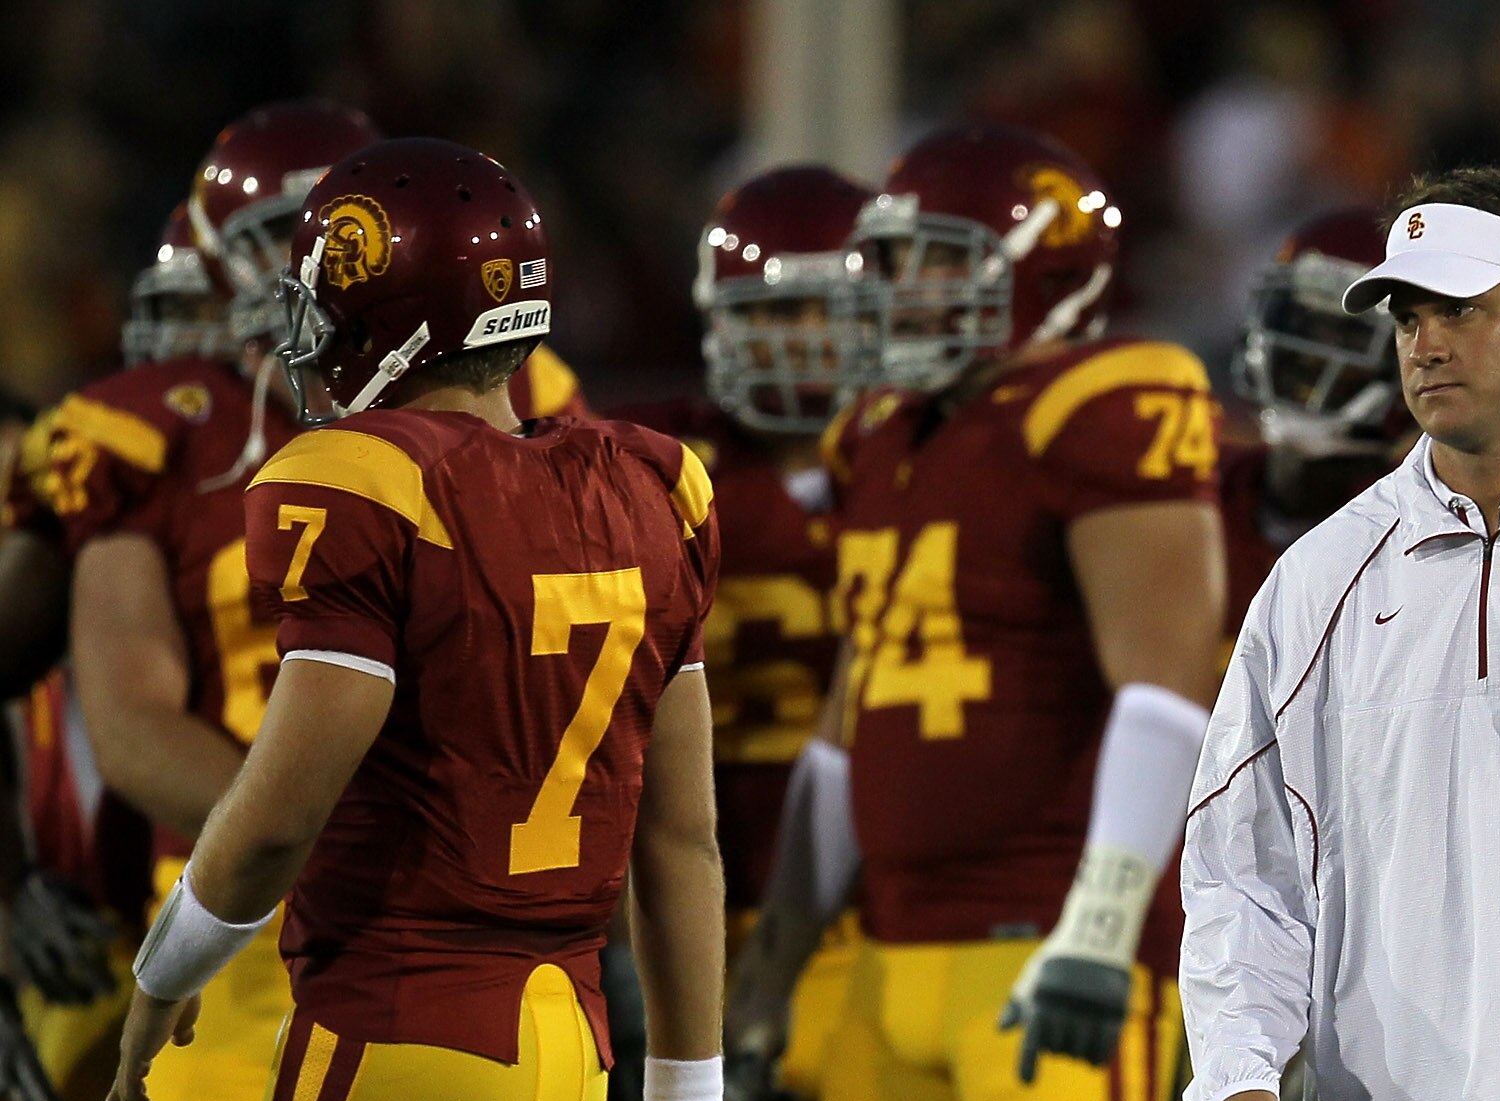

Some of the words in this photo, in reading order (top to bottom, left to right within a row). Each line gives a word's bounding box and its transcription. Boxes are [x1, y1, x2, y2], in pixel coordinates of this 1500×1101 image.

[1407, 212, 1425, 240] SC
[482, 307, 548, 335] schutt
[1134, 391, 1219, 481] 74
[277, 503, 327, 602] 7
[830, 518, 994, 746] 74
[508, 566, 647, 876] 7
